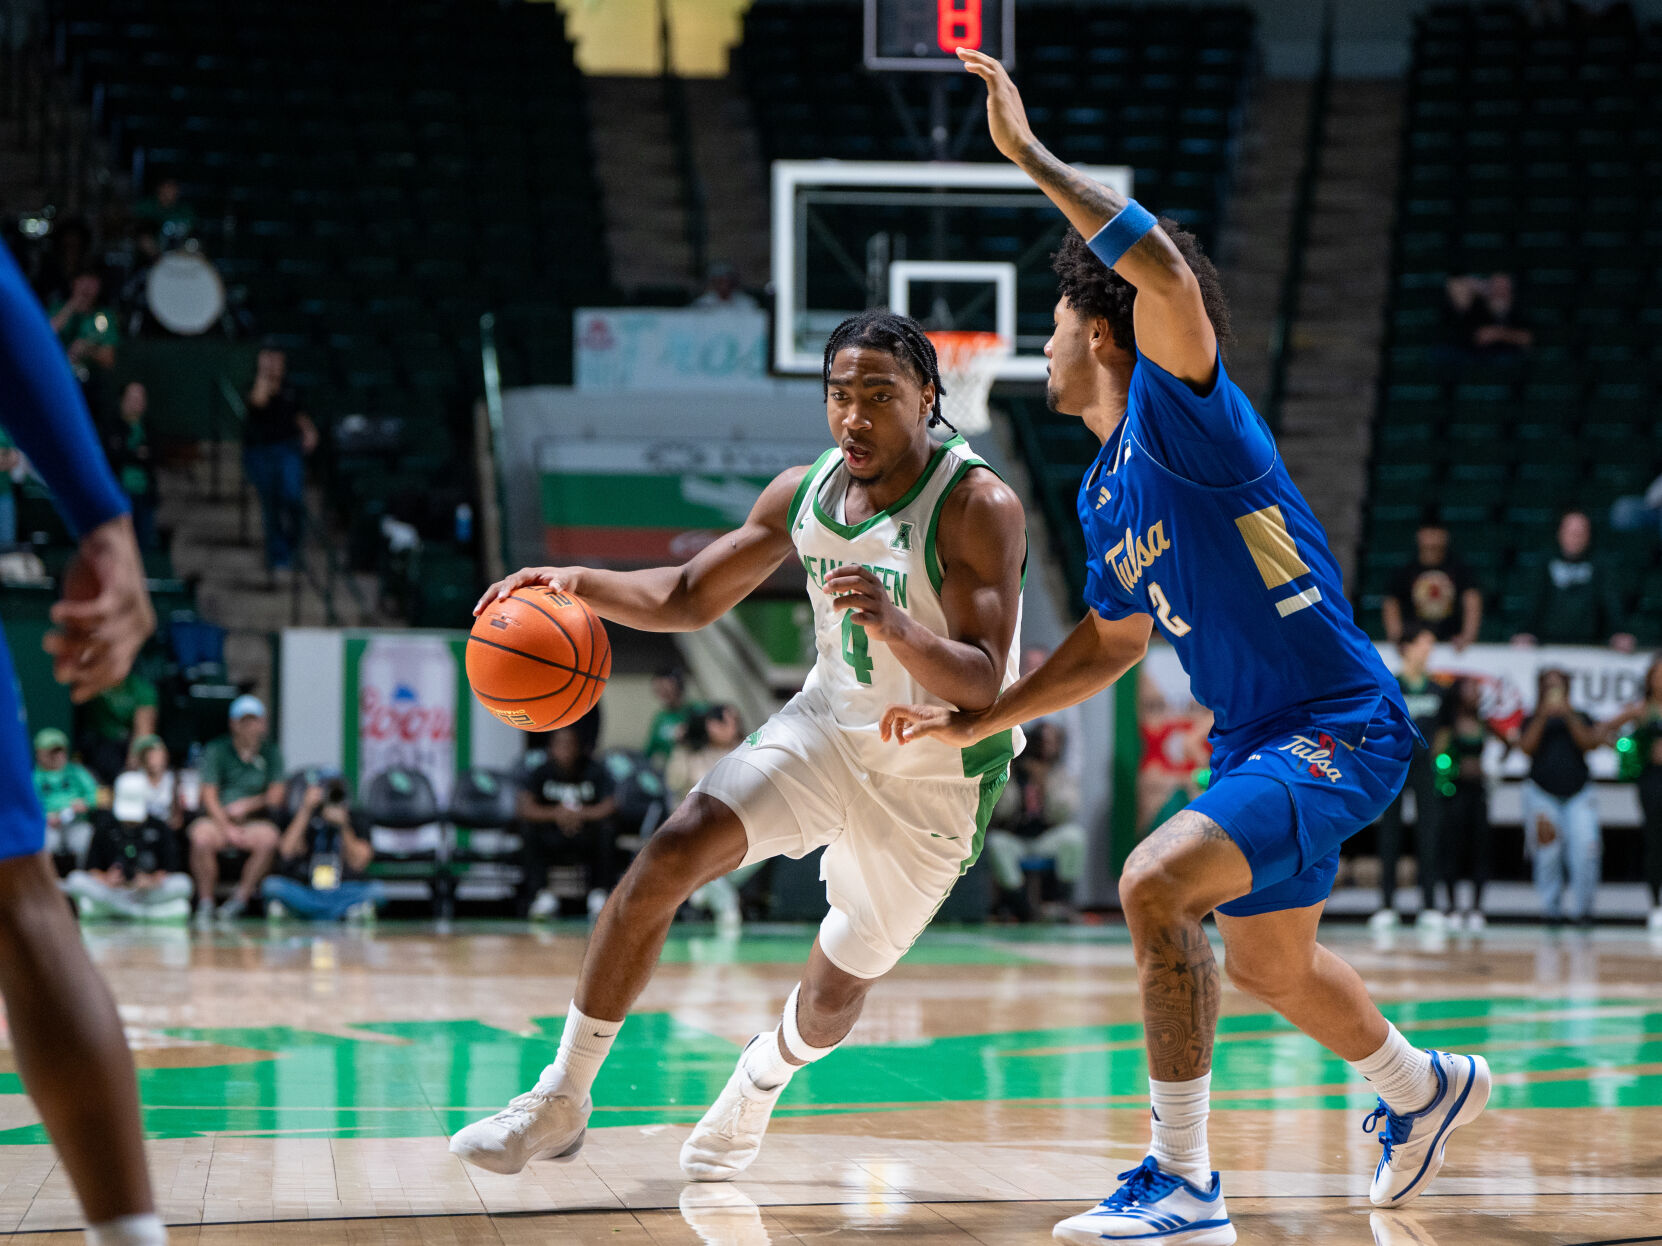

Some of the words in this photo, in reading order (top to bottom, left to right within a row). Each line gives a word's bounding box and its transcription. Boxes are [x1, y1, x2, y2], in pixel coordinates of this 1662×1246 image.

[1105, 519, 1171, 595] Tulsa
[1147, 581, 1192, 637] 2
[841, 608, 874, 685] 4
[1278, 735, 1342, 783] Tulsa
